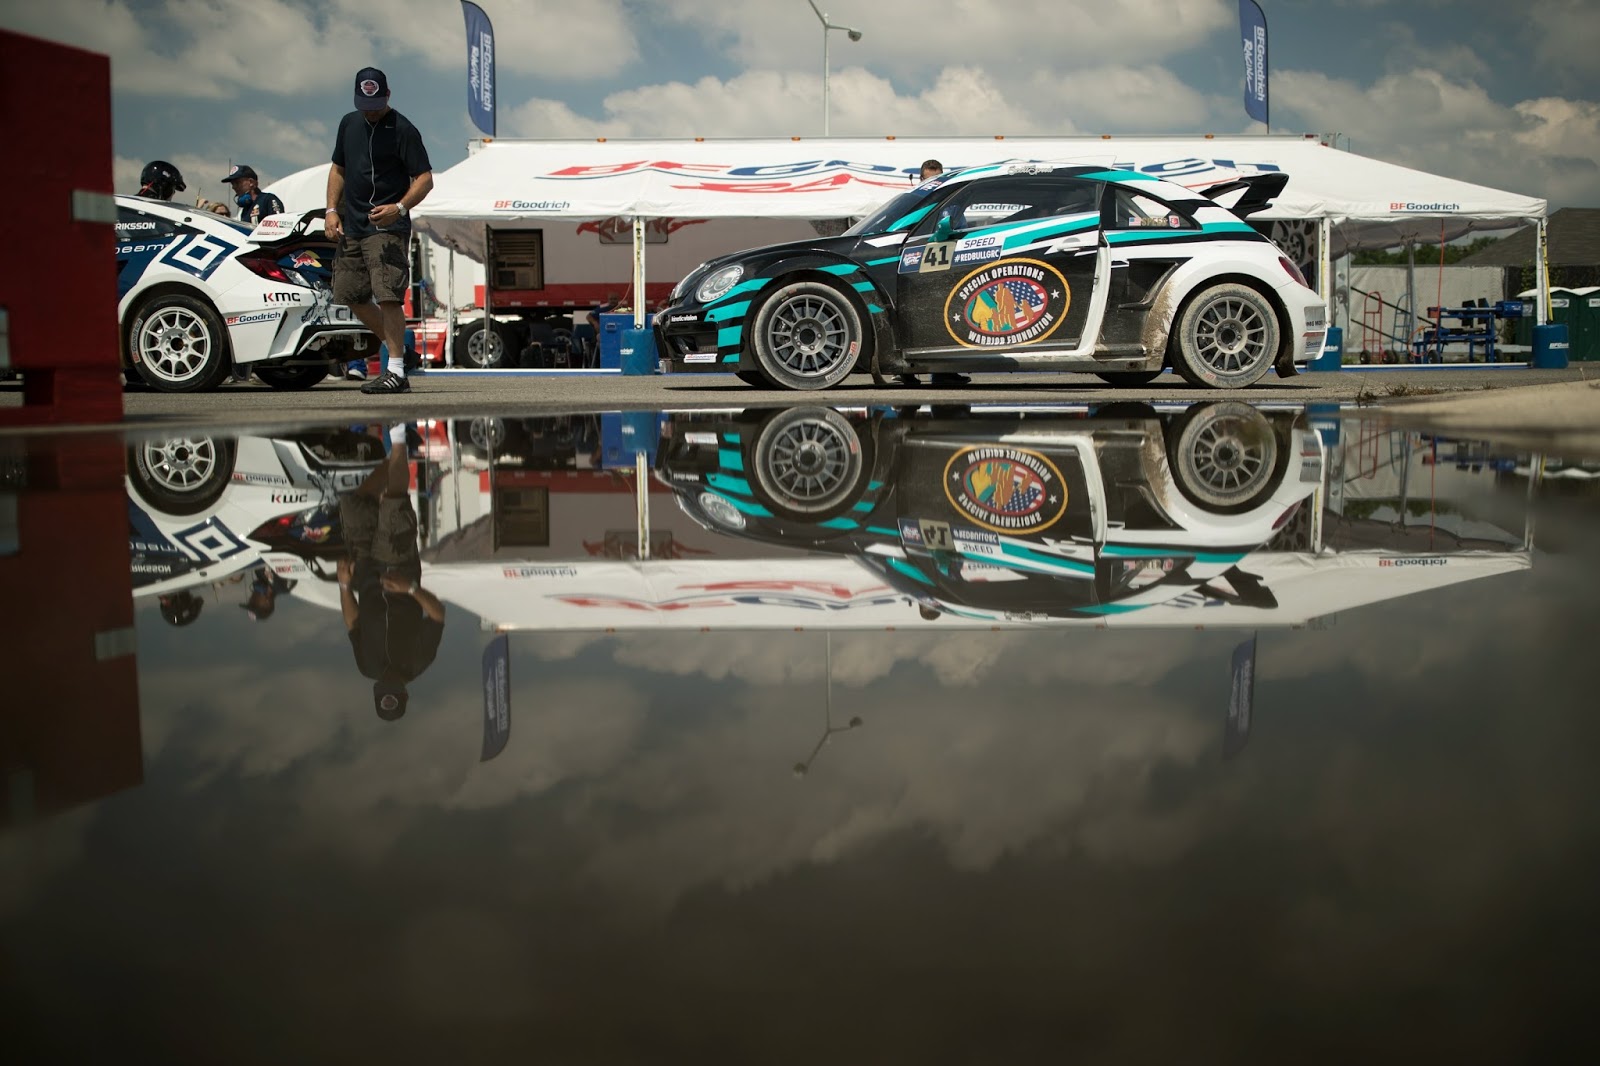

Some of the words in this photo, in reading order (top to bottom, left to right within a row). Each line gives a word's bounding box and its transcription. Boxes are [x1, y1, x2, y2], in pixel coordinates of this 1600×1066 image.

[1256, 26, 1265, 101] BFGoodrich
[483, 33, 493, 112] BFGoodrich
[494, 200, 570, 209] BFGoodrich
[1390, 202, 1460, 210] BFGoodrich
[115, 222, 156, 231] RIKSSON
[963, 237, 996, 248] SPEED
[924, 246, 949, 266] 41
[954, 249, 1000, 263] #REDBULLGRC
[959, 272, 990, 300] SPECIAL
[991, 265, 1045, 281] OPERATIONS
[227, 311, 281, 325] BFGoodrich
[968, 330, 1005, 346] WARRIOR
[1006, 312, 1054, 344] FOUNDATION
